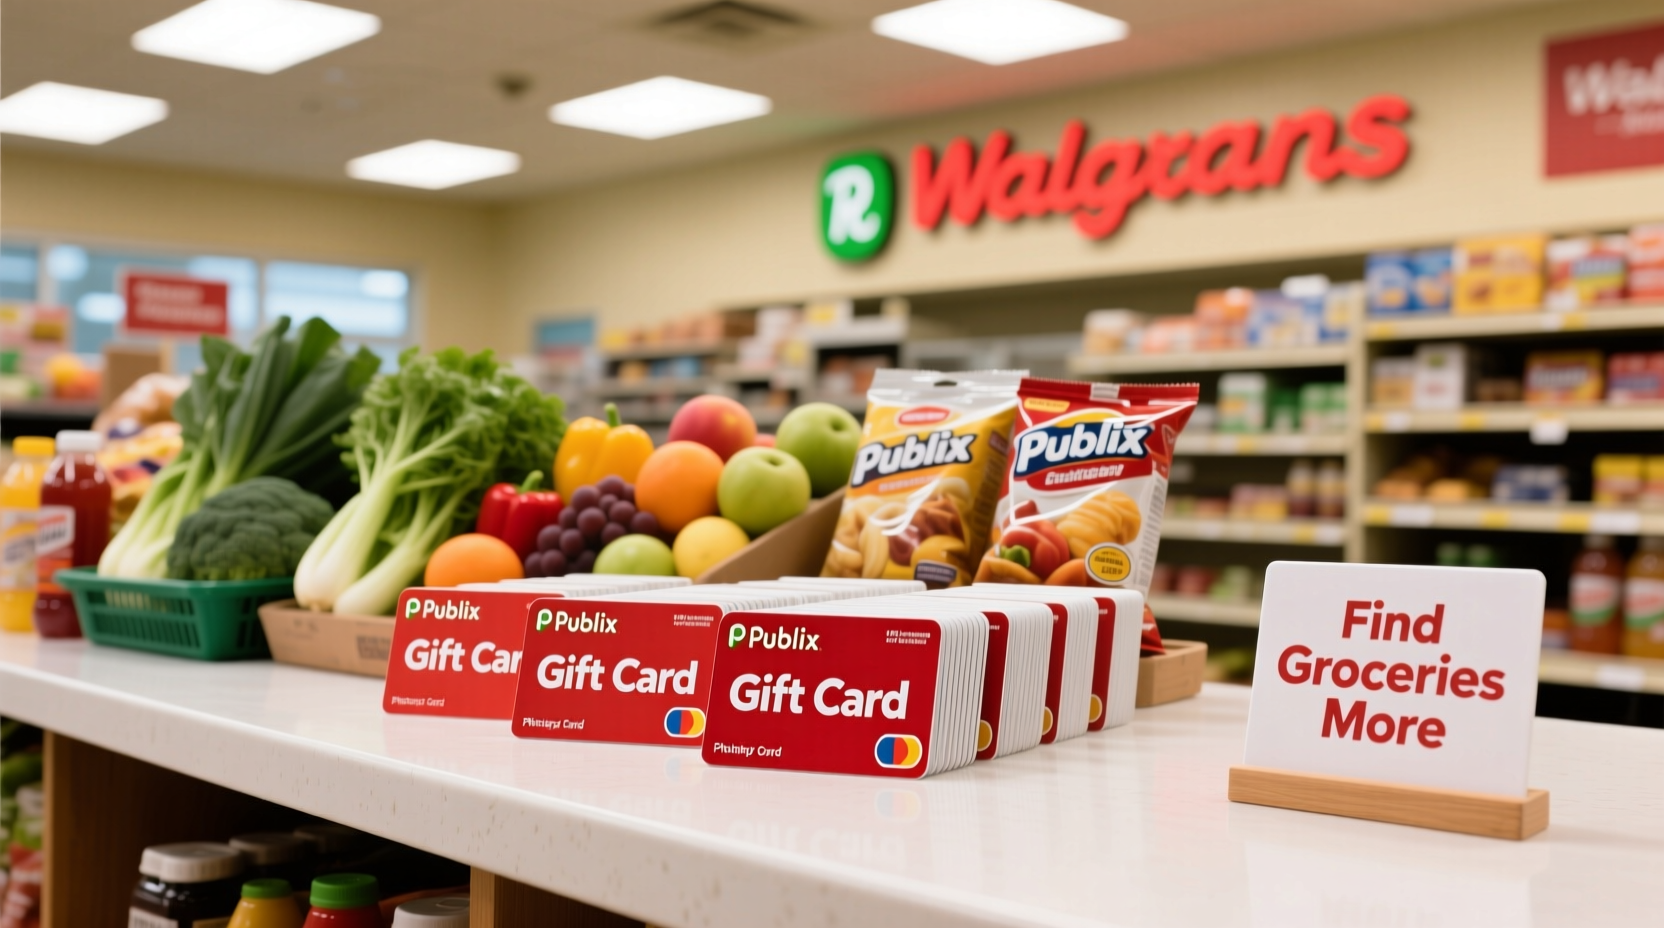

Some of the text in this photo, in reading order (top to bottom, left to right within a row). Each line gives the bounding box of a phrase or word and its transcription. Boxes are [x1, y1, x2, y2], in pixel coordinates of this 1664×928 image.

[851, 430, 976, 487] Publix
[1016, 420, 1149, 473] Publix
[422, 598, 481, 621] Publix
[554, 611, 618, 634] Publix
[1341, 599, 1446, 645] Find
[404, 637, 466, 672] Gift
[470, 640, 523, 674] Car
[748, 626, 820, 651] Publix
[536, 653, 699, 695] Gift Card
[1277, 644, 1506, 701] Groceries
[729, 673, 910, 720] Gift Card
[1320, 697, 1447, 750] More
